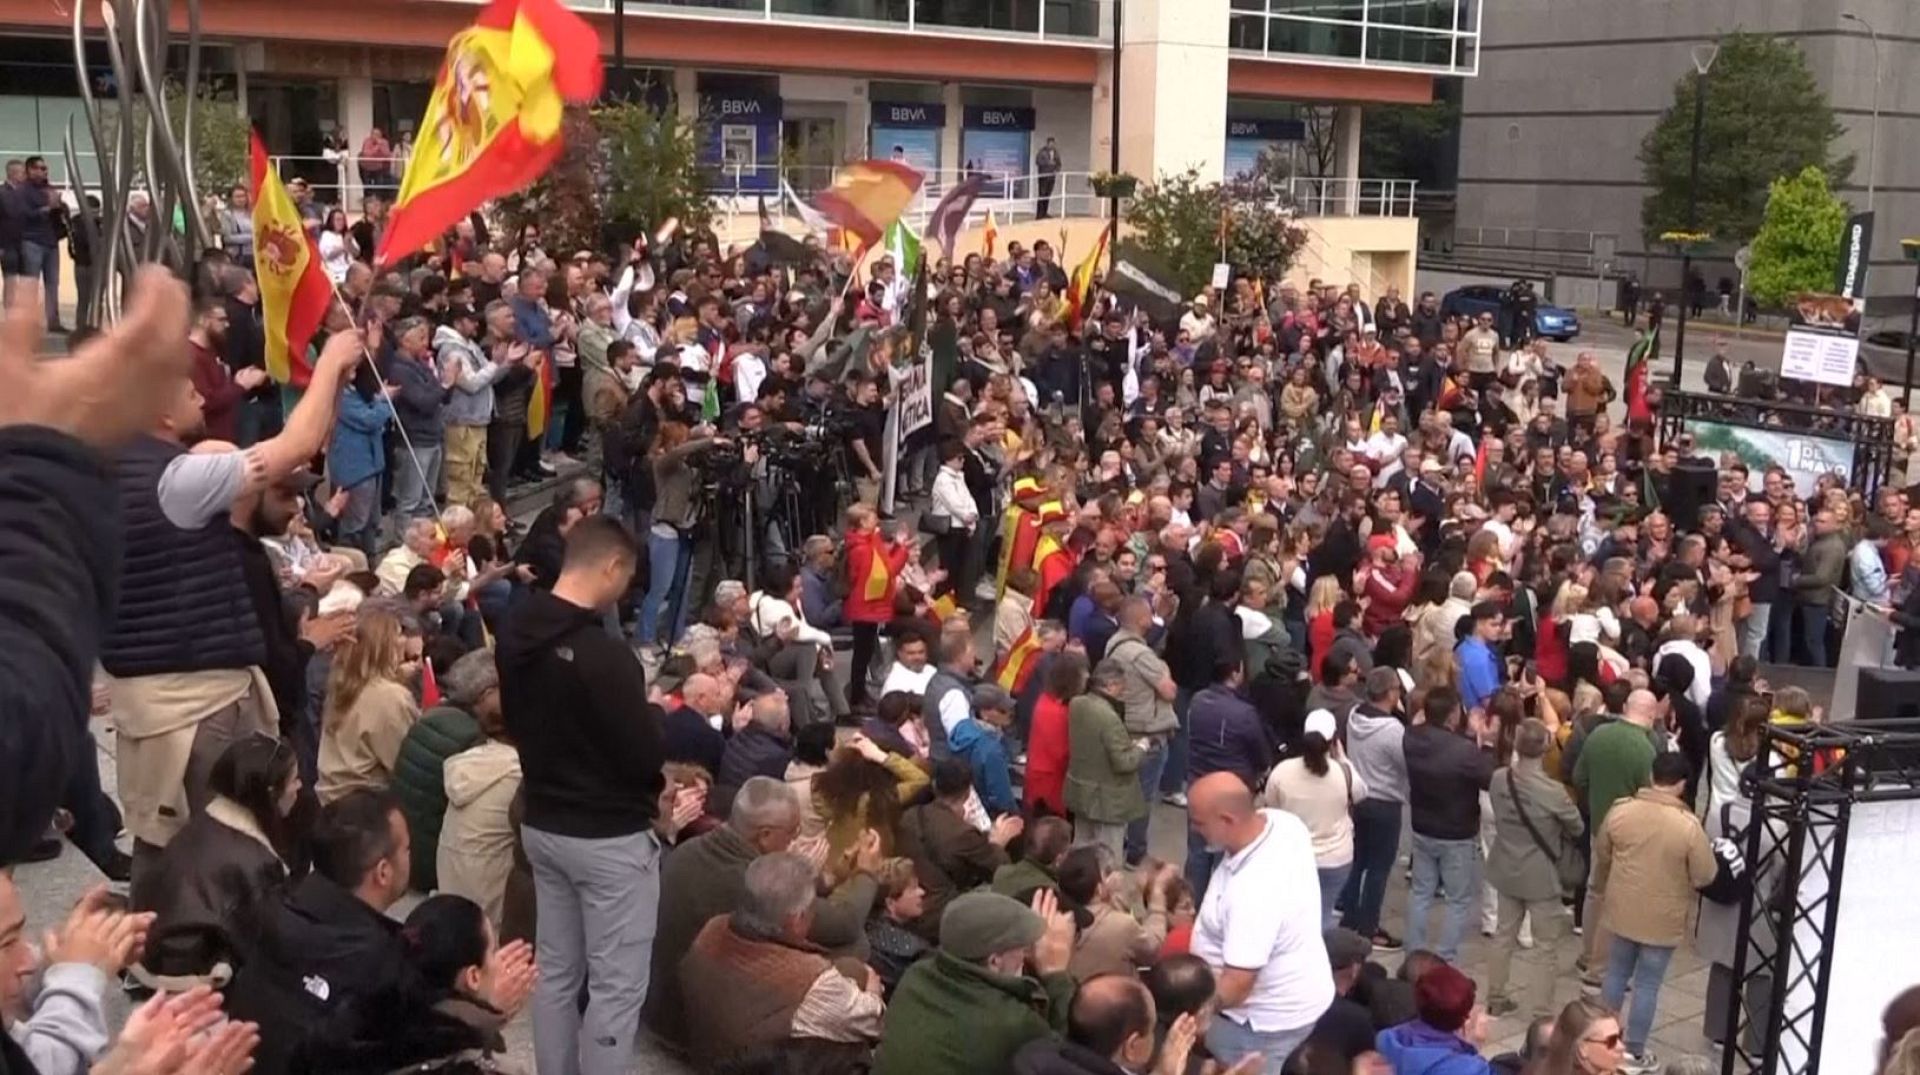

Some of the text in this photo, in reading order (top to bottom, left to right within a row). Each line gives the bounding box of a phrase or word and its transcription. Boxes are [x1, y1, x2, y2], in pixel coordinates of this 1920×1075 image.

[722, 101, 761, 114] BBVA
[891, 107, 927, 121] BBVA
[982, 111, 1016, 125] BBVA
[1231, 122, 1259, 135] BBVA
[1801, 460, 1847, 476] MAYO
